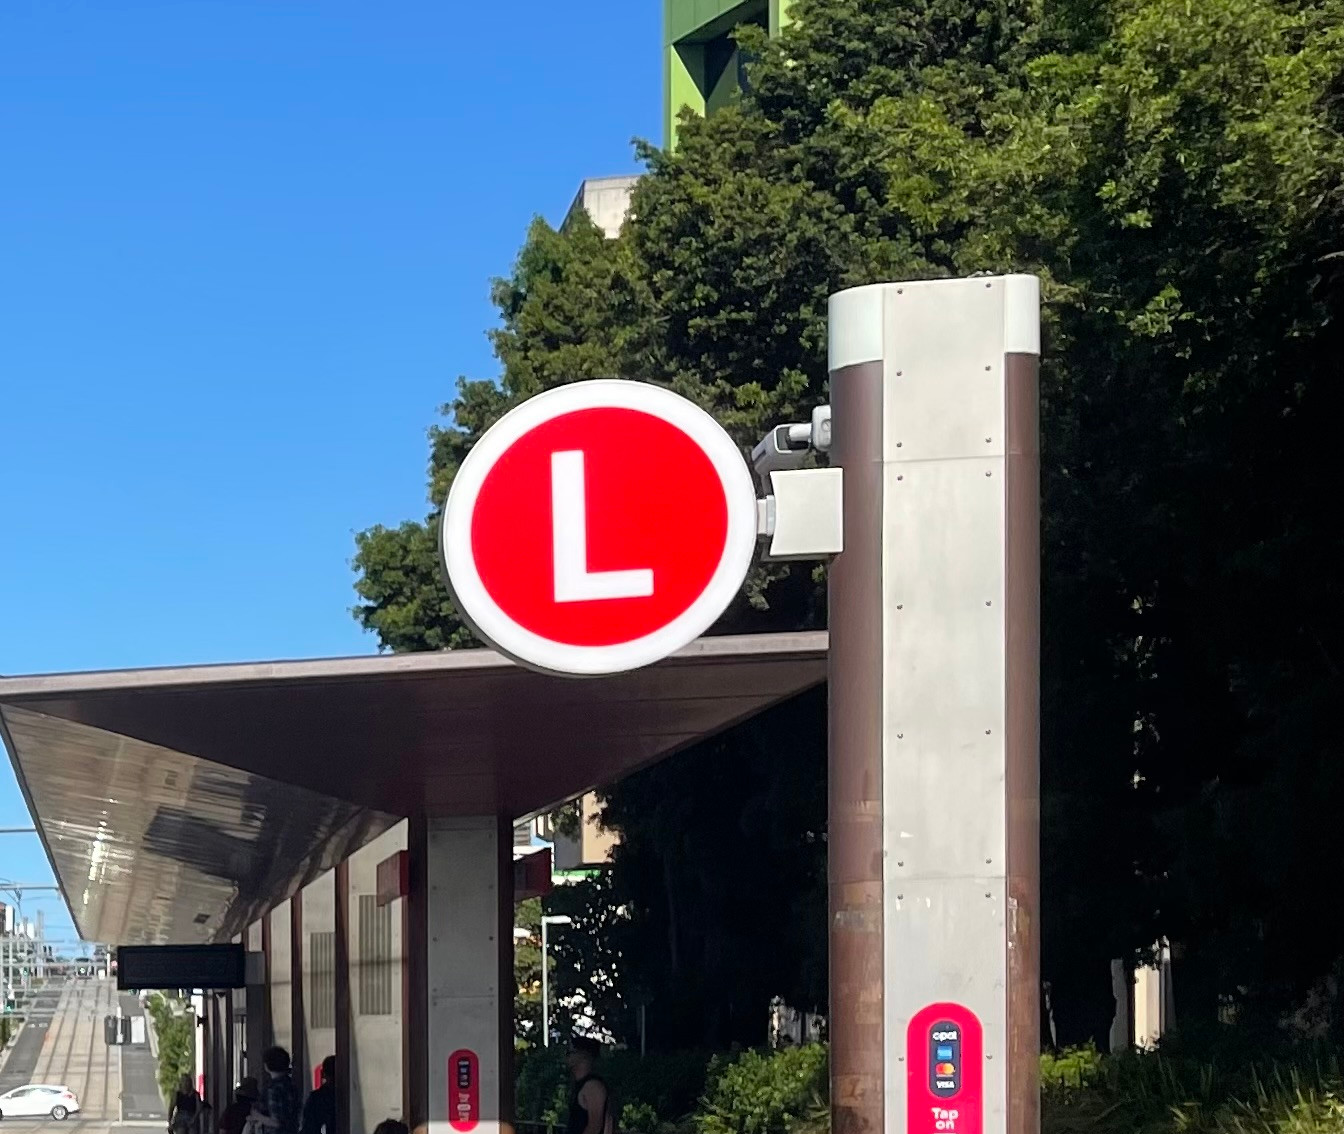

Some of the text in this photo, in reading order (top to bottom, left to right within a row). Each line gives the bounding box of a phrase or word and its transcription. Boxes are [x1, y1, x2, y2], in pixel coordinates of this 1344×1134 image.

[551, 450, 654, 602] L
[931, 1107, 959, 1121] Tap
[935, 1120, 955, 1130] on
